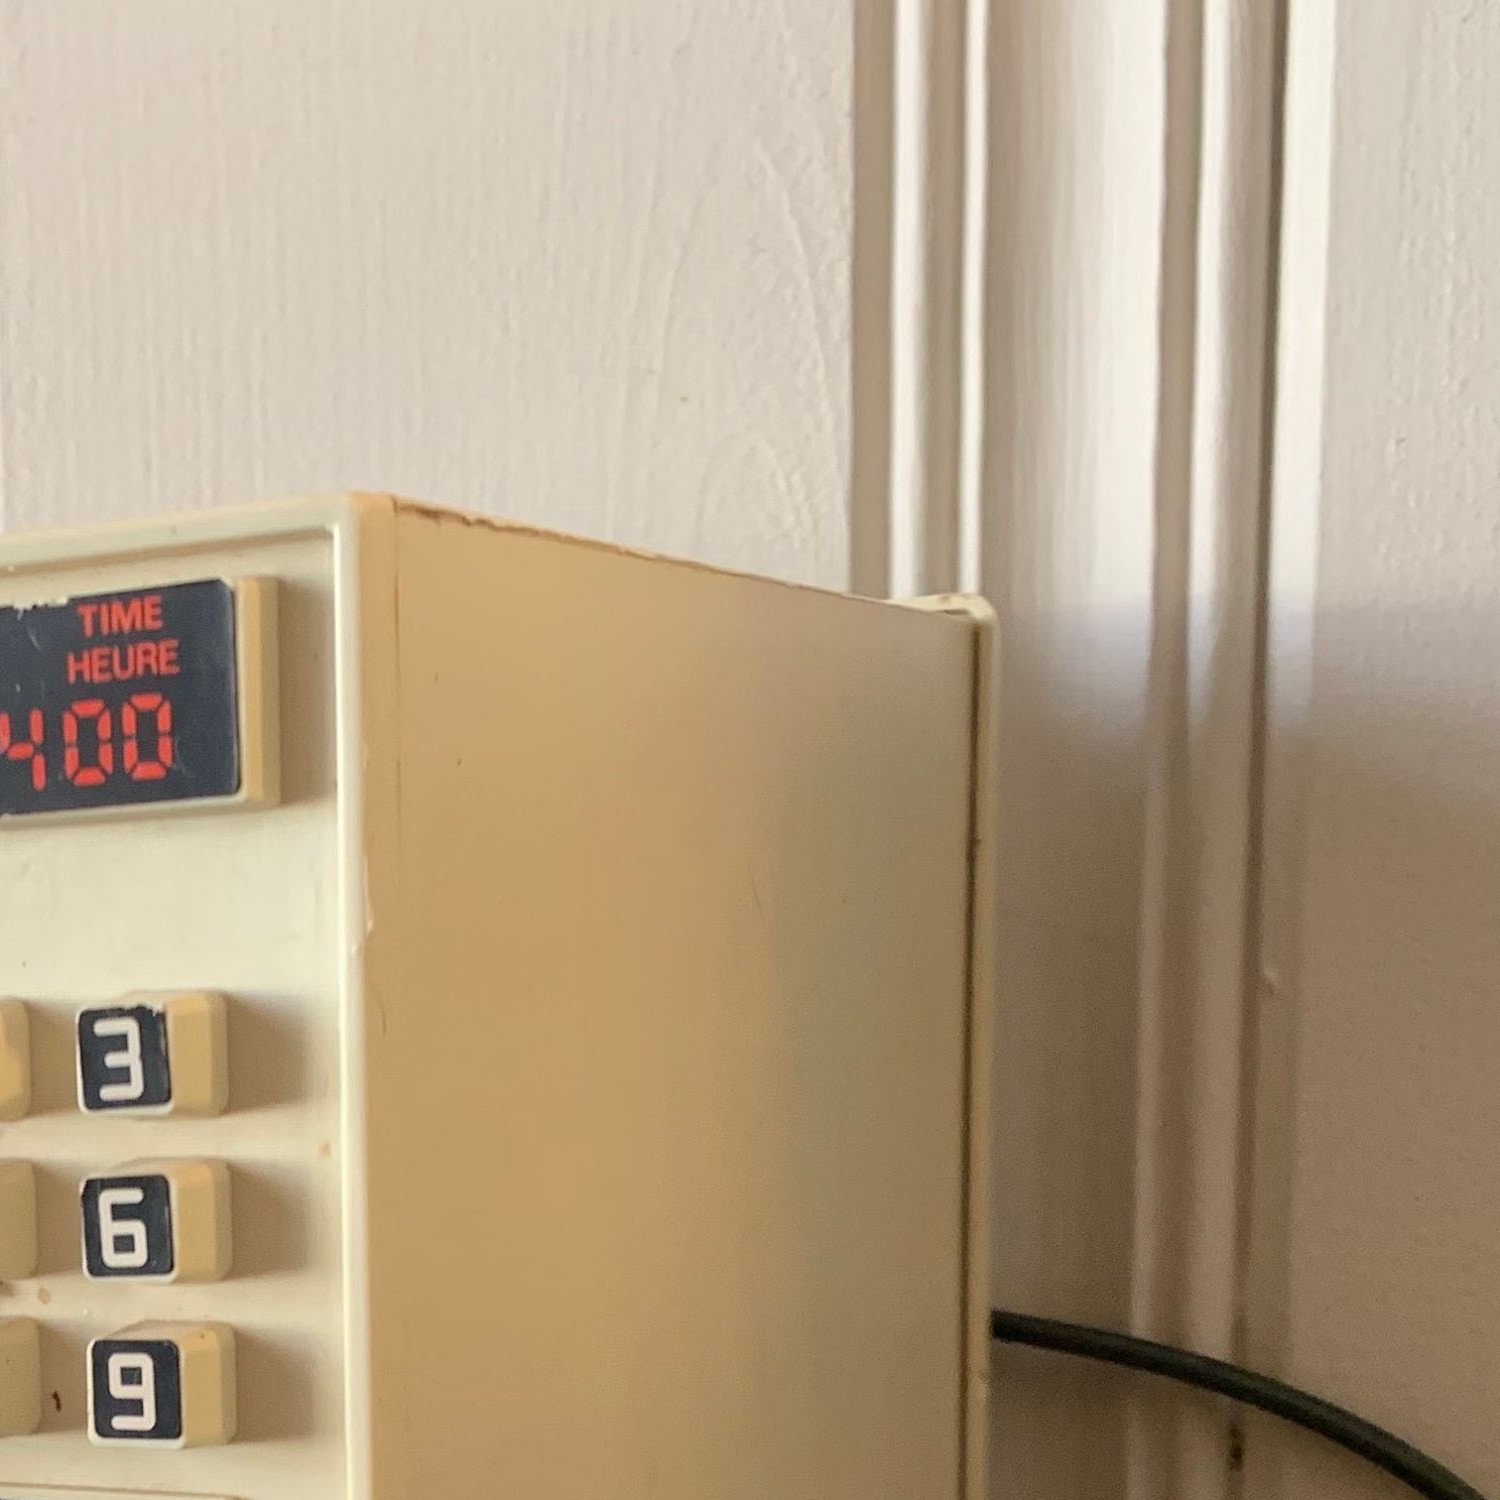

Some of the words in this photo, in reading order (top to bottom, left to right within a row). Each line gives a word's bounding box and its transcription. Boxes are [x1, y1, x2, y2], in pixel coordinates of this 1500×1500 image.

[77, 595, 164, 637] TIME
[66, 638, 180, 684] HEURE
[94, 1016, 145, 1102] 3
[98, 1186, 149, 1269] 6
[107, 1352, 157, 1432] 9
